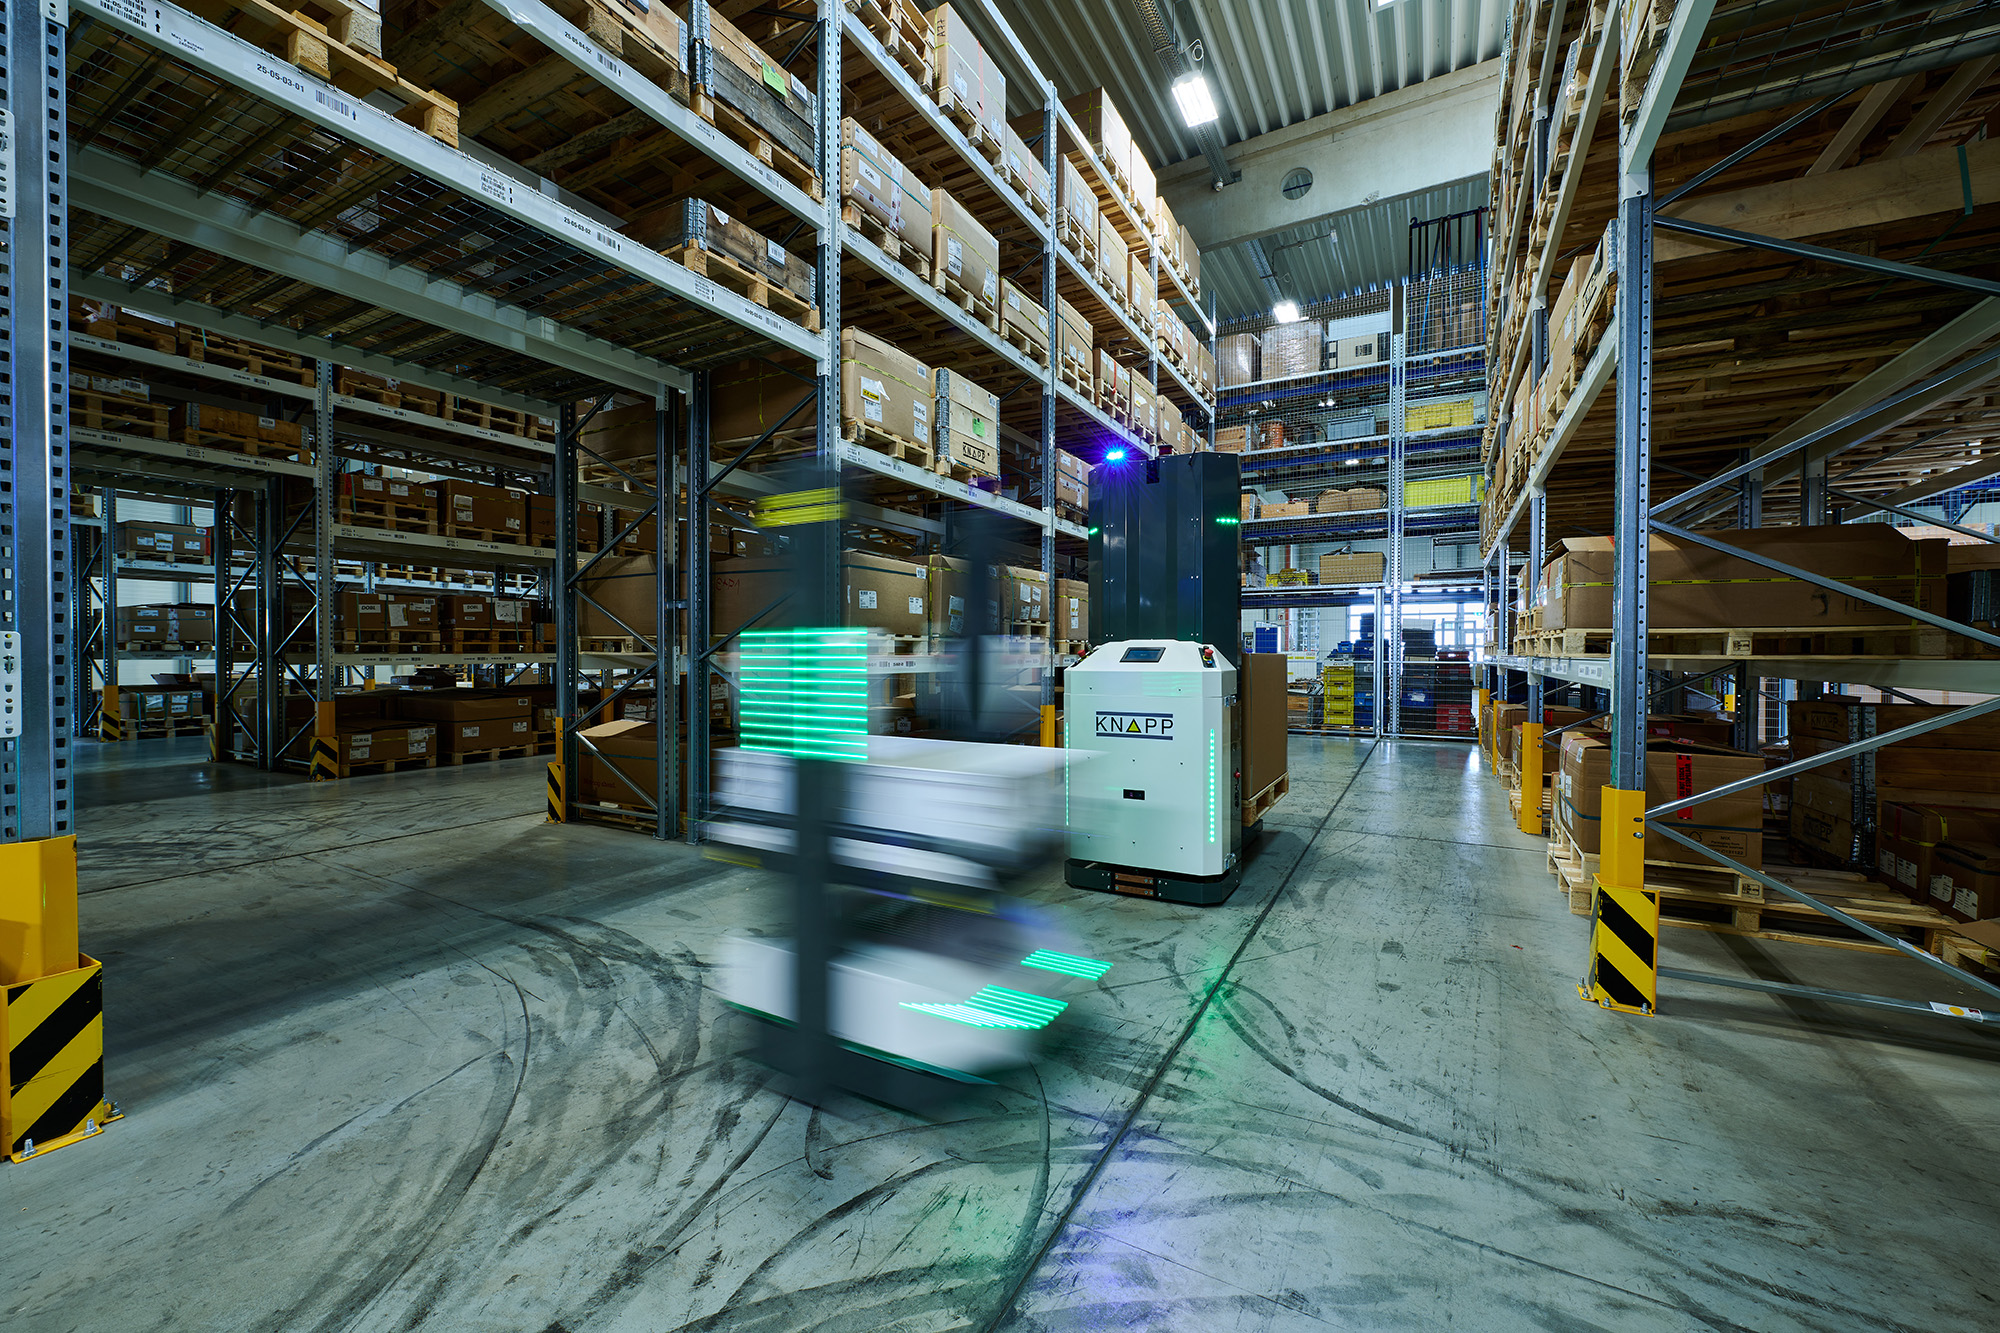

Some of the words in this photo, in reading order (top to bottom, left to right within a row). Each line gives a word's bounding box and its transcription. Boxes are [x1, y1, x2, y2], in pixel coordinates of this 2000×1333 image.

[256, 63, 305, 93] 25-05-03-01
[563, 216, 592, 236] 25-05-03-02
[963, 445, 986, 462] KNAPP
[1095, 716, 1174, 735] KNAPP
